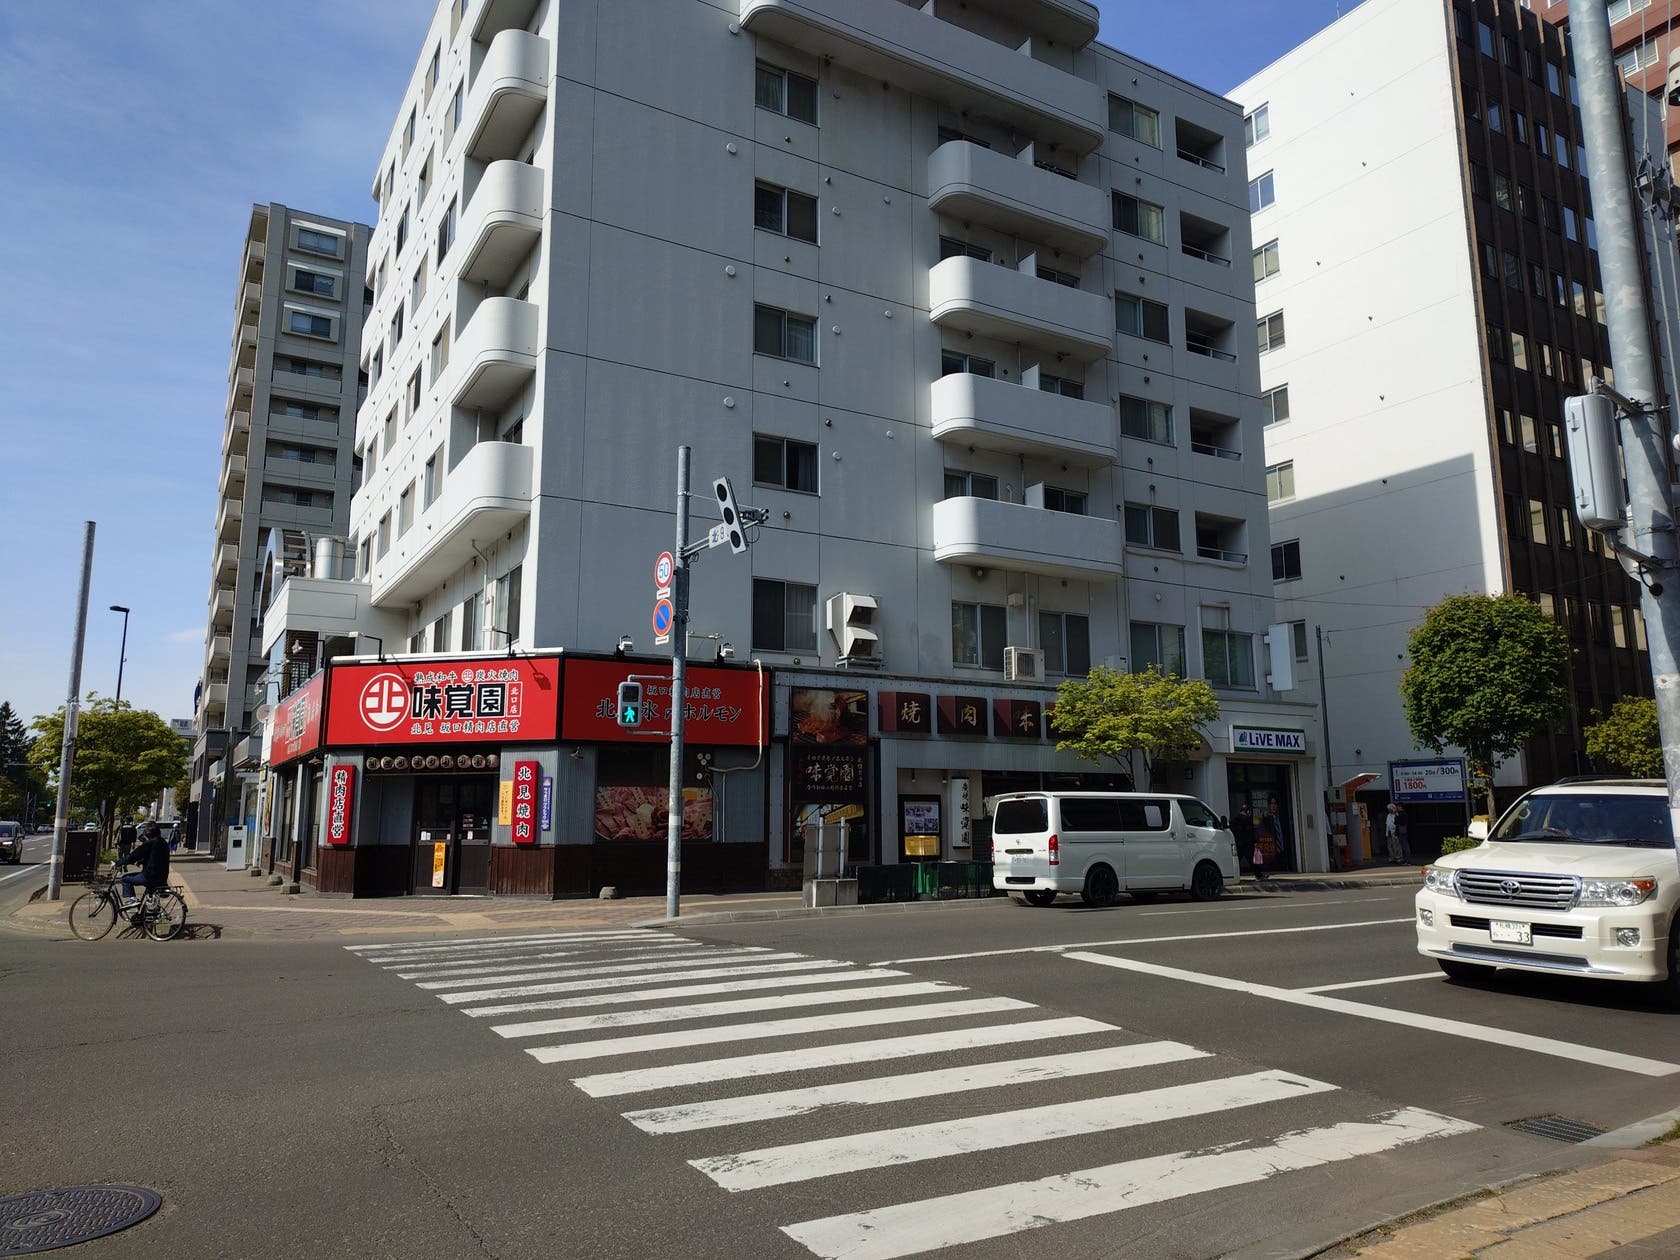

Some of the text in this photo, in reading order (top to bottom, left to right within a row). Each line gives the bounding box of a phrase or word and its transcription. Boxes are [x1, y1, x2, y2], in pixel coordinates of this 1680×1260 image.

[658, 561, 670, 579] 50
[475, 668, 519, 682] 炭火焼肉
[411, 683, 506, 720] 味覚園
[510, 686, 519, 714] 北口店
[411, 723, 434, 735] 北見
[1275, 734, 1301, 748] MAX
[330, 769, 347, 839] 精肉店直営
[516, 765, 532, 838] 北見焼肉
[1516, 931, 1530, 943] 33
